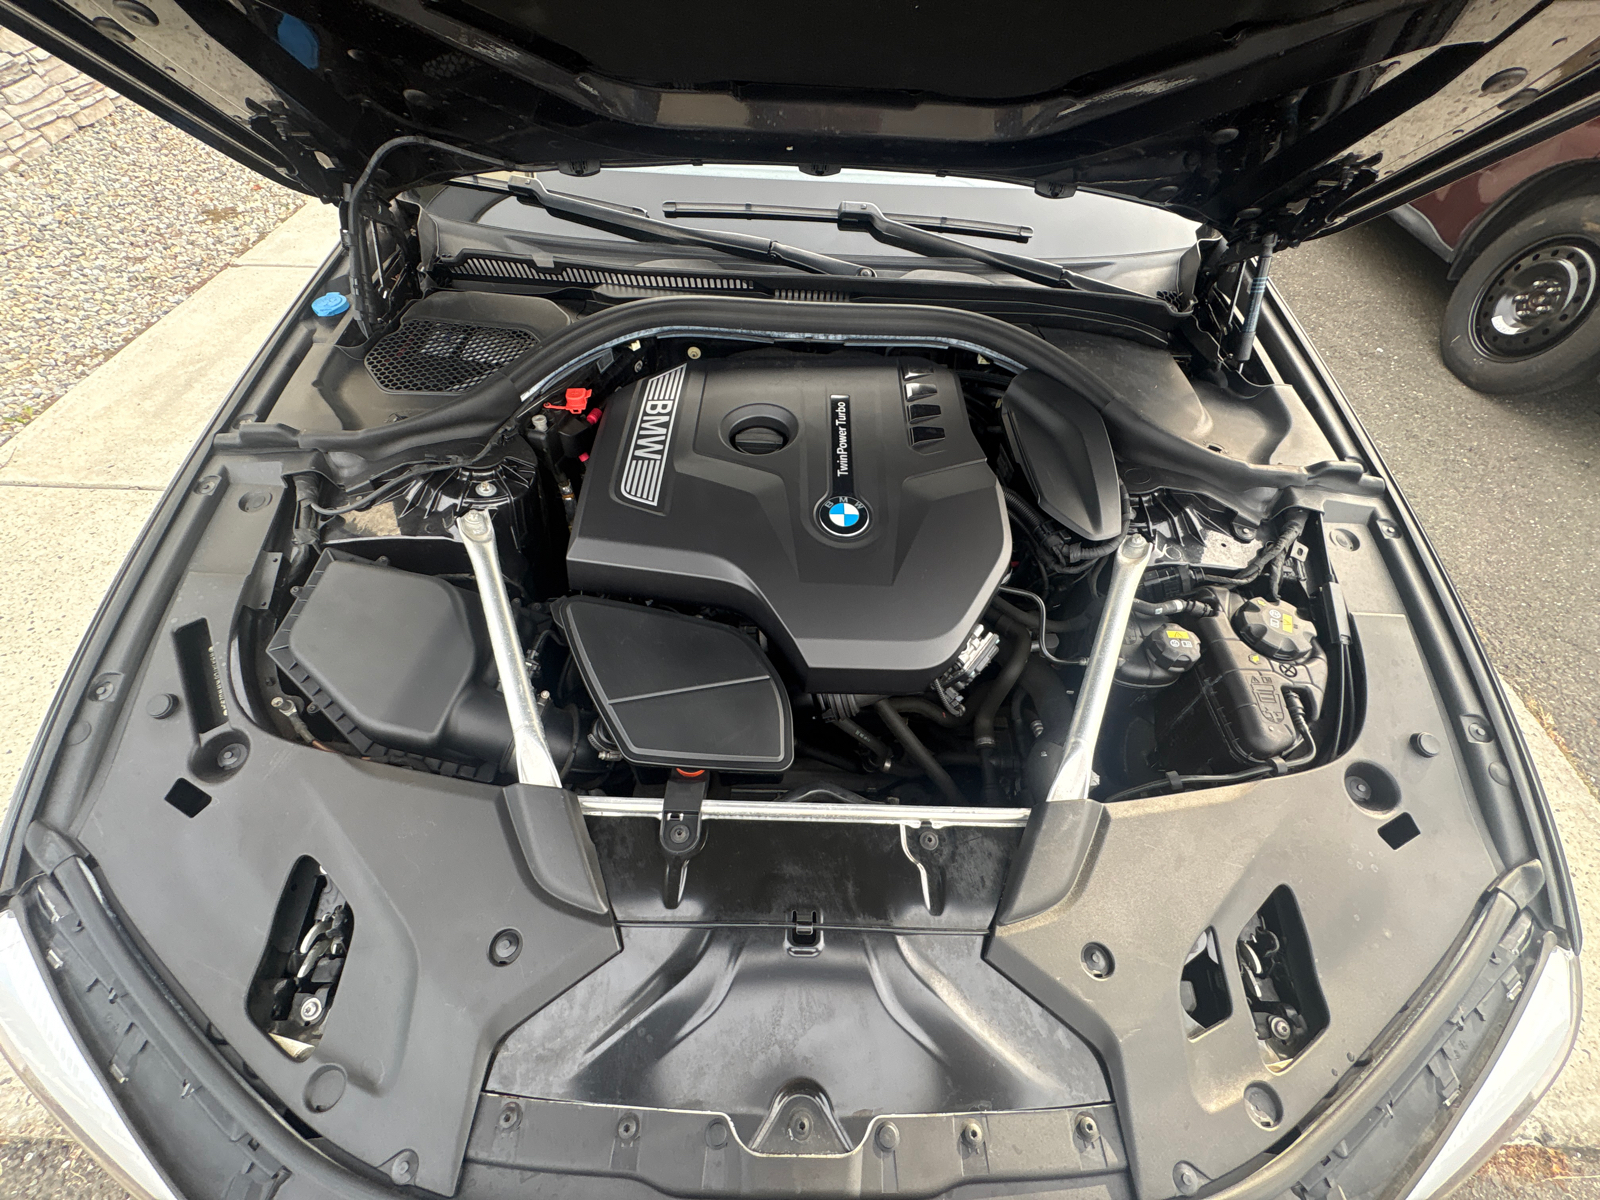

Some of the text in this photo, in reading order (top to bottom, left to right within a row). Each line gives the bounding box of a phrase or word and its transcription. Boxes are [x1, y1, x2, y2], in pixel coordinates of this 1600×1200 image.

[633, 400, 674, 460] BMW
[835, 401, 849, 477] TwinPower Turbo
[824, 496, 864, 510] BMW
